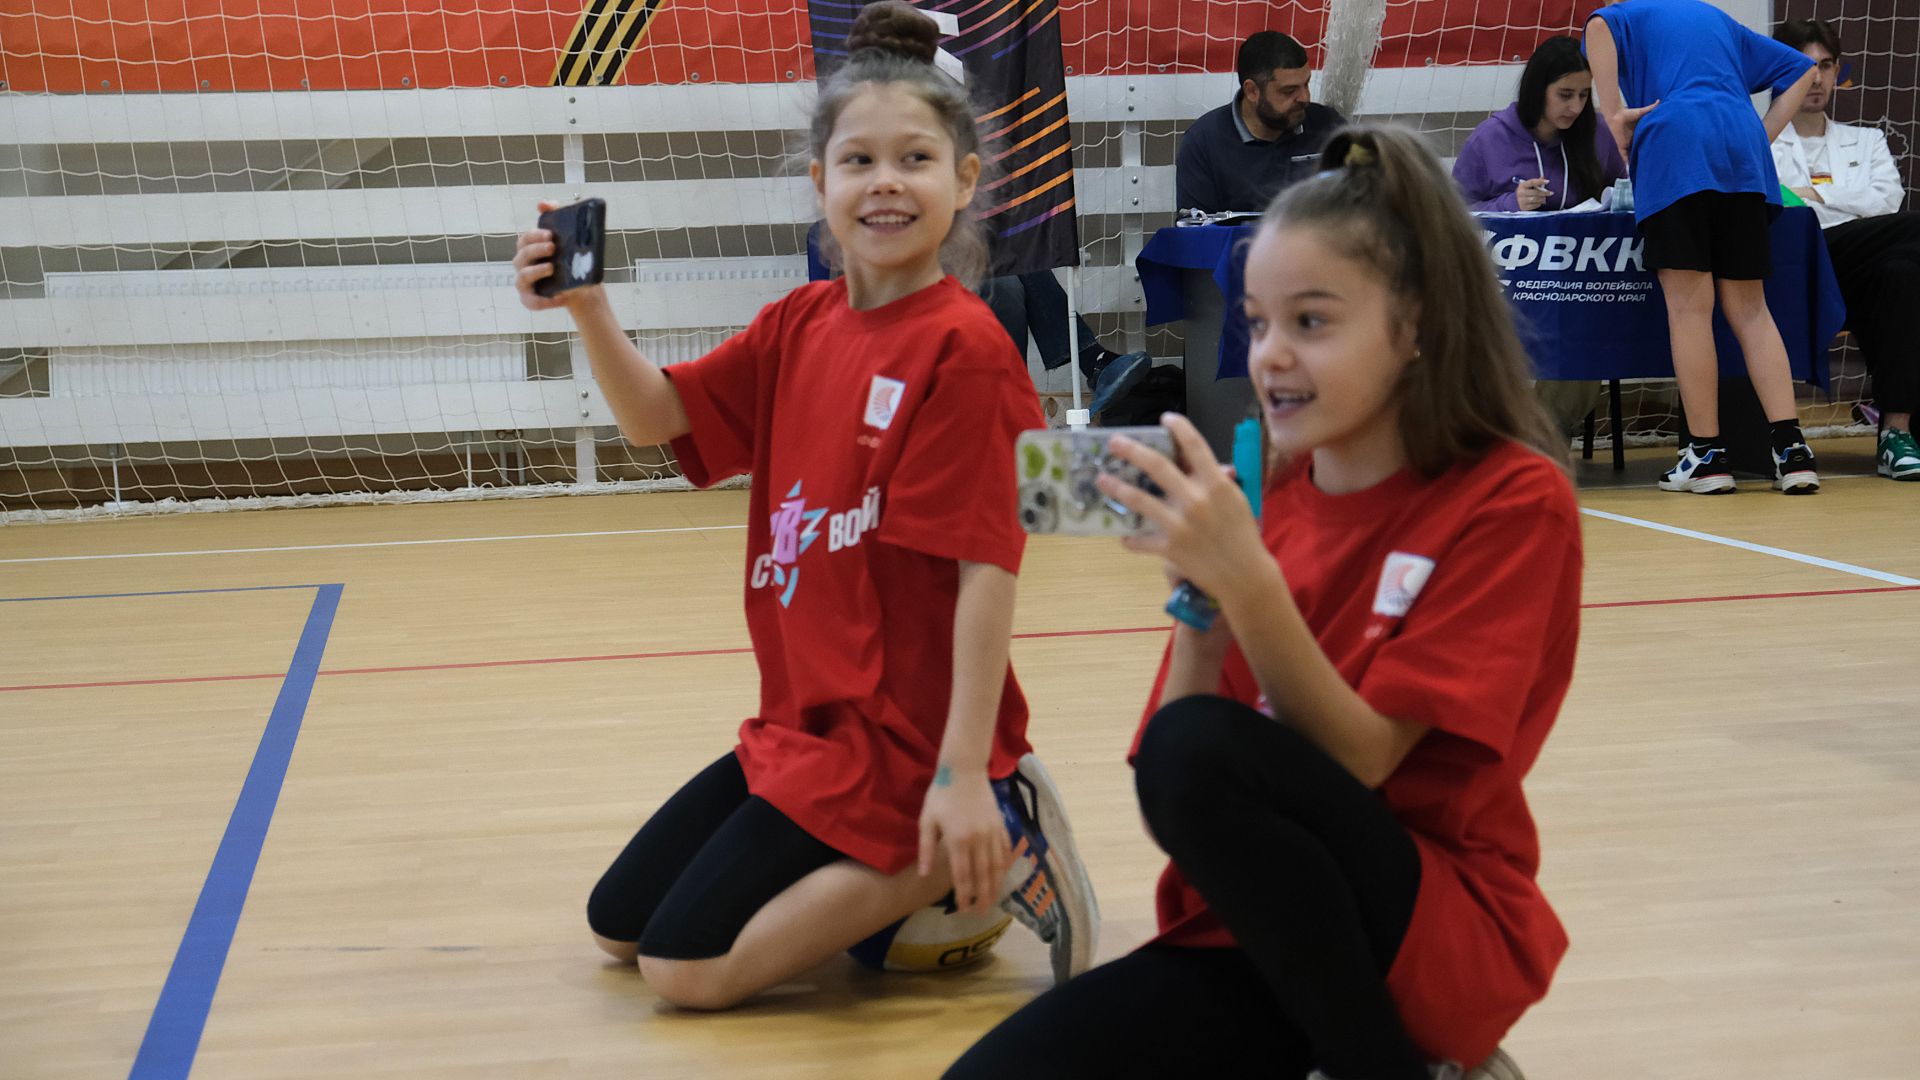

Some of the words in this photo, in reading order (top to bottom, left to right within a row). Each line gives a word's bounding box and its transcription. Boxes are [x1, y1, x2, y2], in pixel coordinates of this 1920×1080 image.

[1491, 234, 1647, 272] ФВКК
[1515, 280, 1583, 290] ФЕДЕРАЦИЯ
[1585, 280, 1653, 291] ВОЛЕЙБОЛА
[1512, 292, 1615, 302] КРАСНОДАРСКОГО
[1617, 293, 1646, 302] КРАЯ
